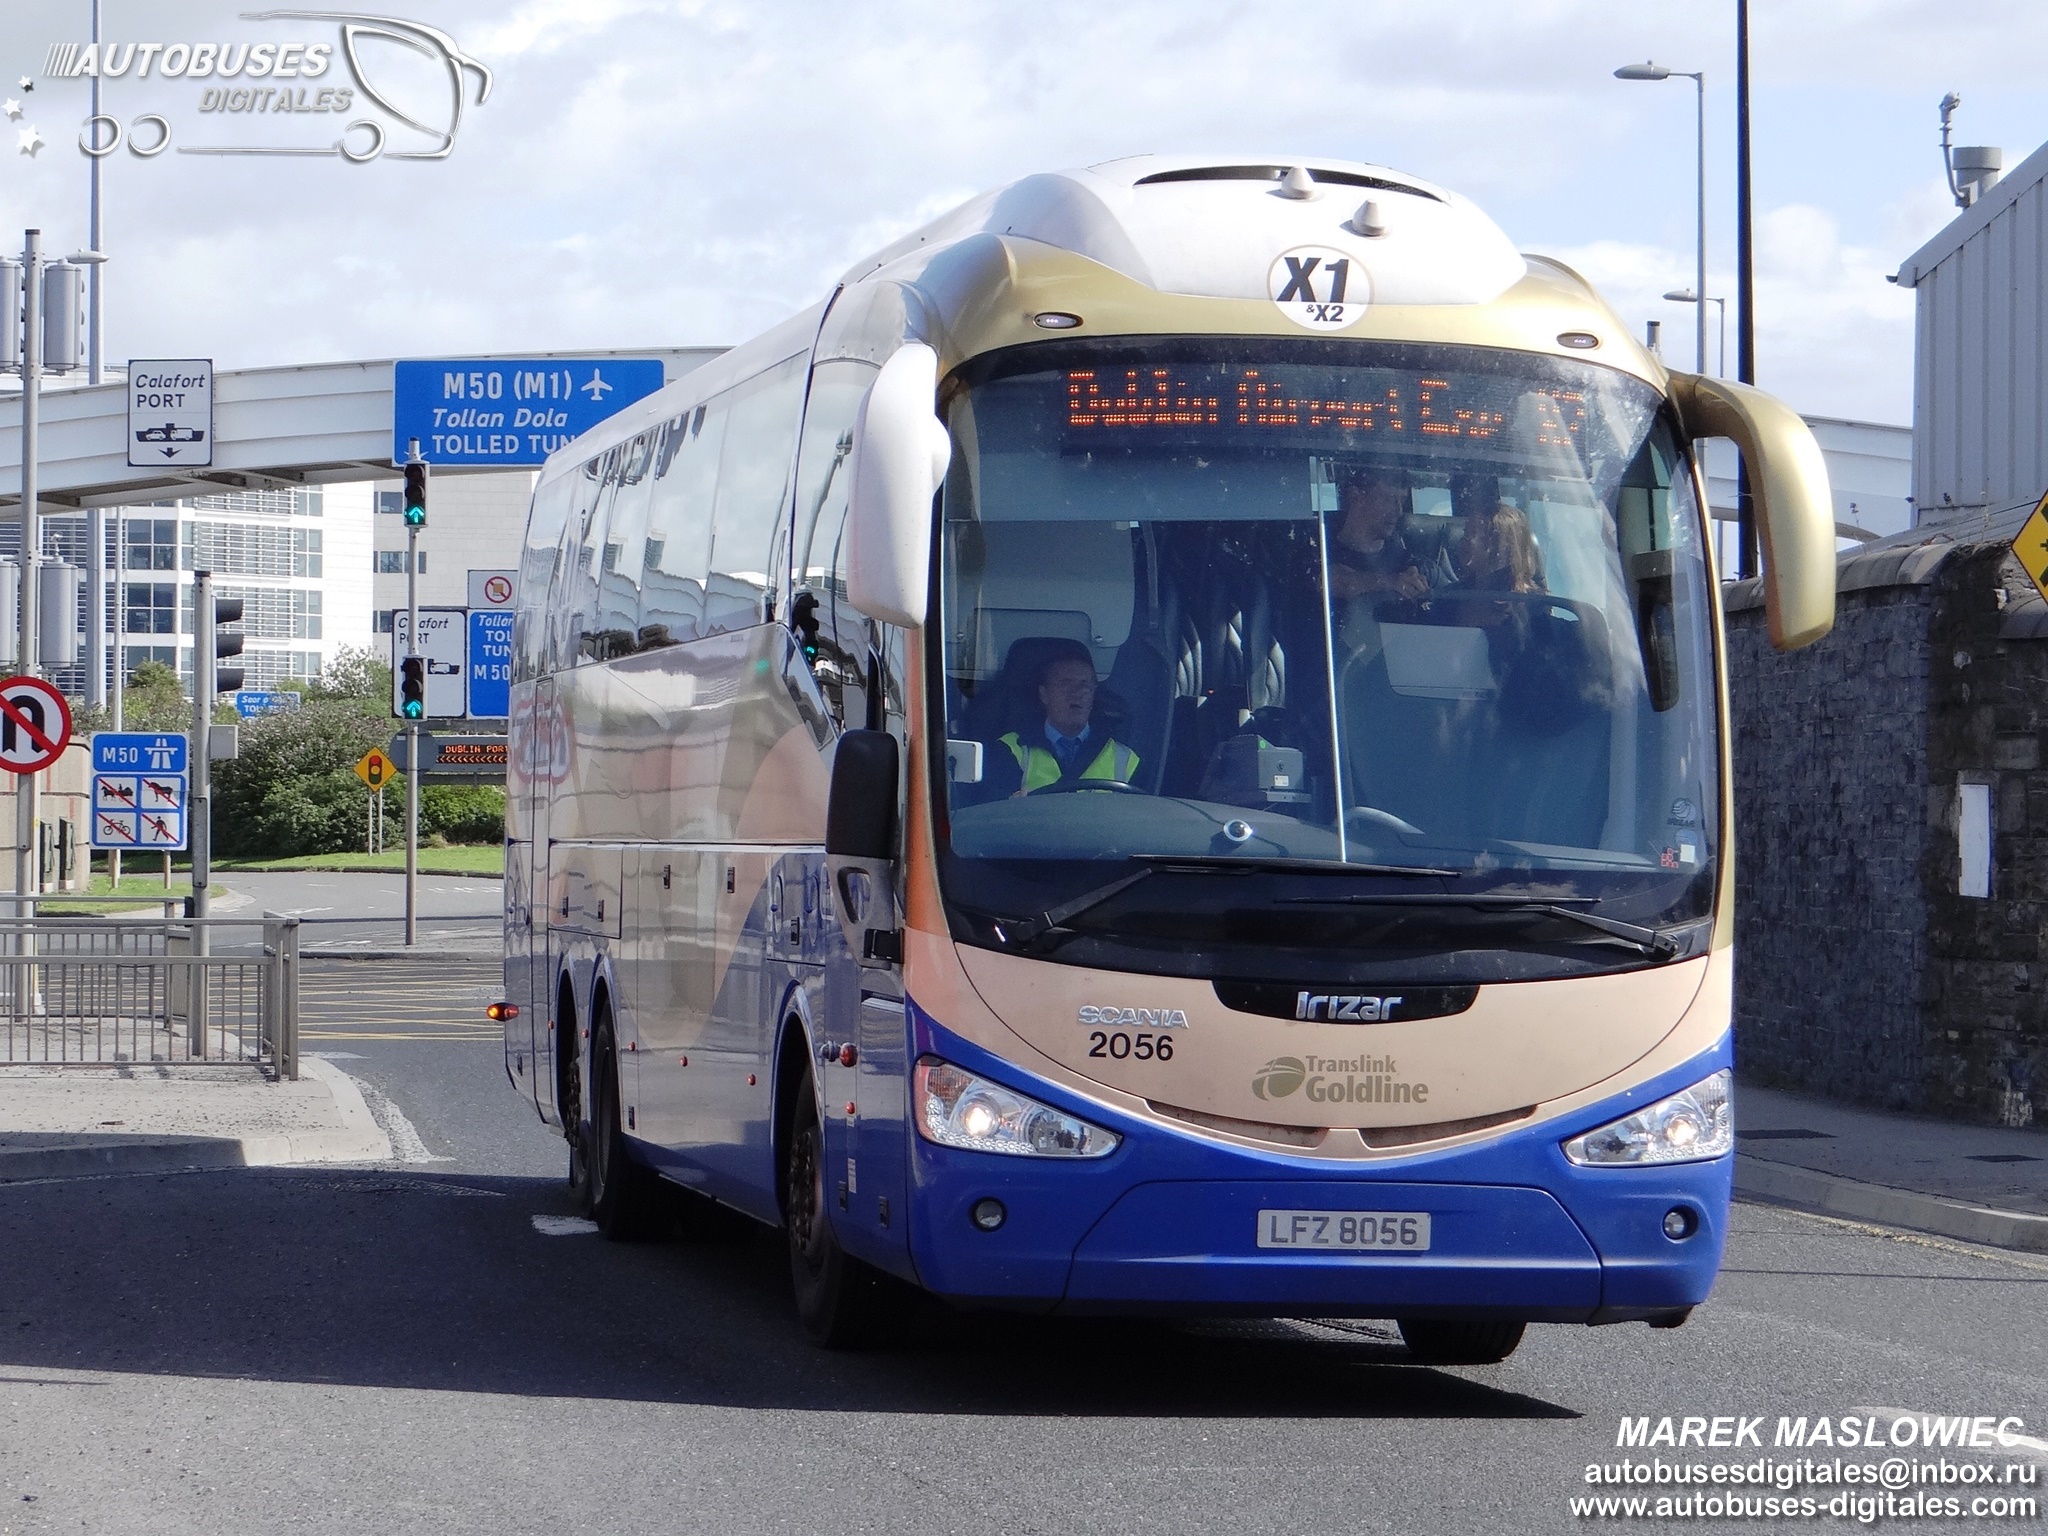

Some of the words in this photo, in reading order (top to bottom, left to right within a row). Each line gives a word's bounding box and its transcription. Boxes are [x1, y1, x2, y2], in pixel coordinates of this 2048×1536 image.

[1276, 257, 1350, 303] X1
[135, 374, 205, 388] Calafort
[444, 372, 503, 399] M50
[513, 370, 572, 400] (M1)
[137, 394, 185, 408] PORT
[433, 408, 504, 428] Tollan
[513, 408, 568, 428] Dola
[431, 434, 520, 454] TOLLED
[398, 617, 449, 629] Cafort
[399, 633, 430, 644] PRT
[103, 747, 138, 763] M50
[445, 745, 481, 753] DUBLIN
[1077, 1005, 1189, 1029] SCANIA
[1089, 1031, 1174, 1061] 2056
[1305, 1055, 1397, 1073] Translink
[1306, 1077, 1429, 1104] Goldline
[1270, 1211, 1330, 1244] LFZ
[1339, 1211, 1418, 1245] 8056
